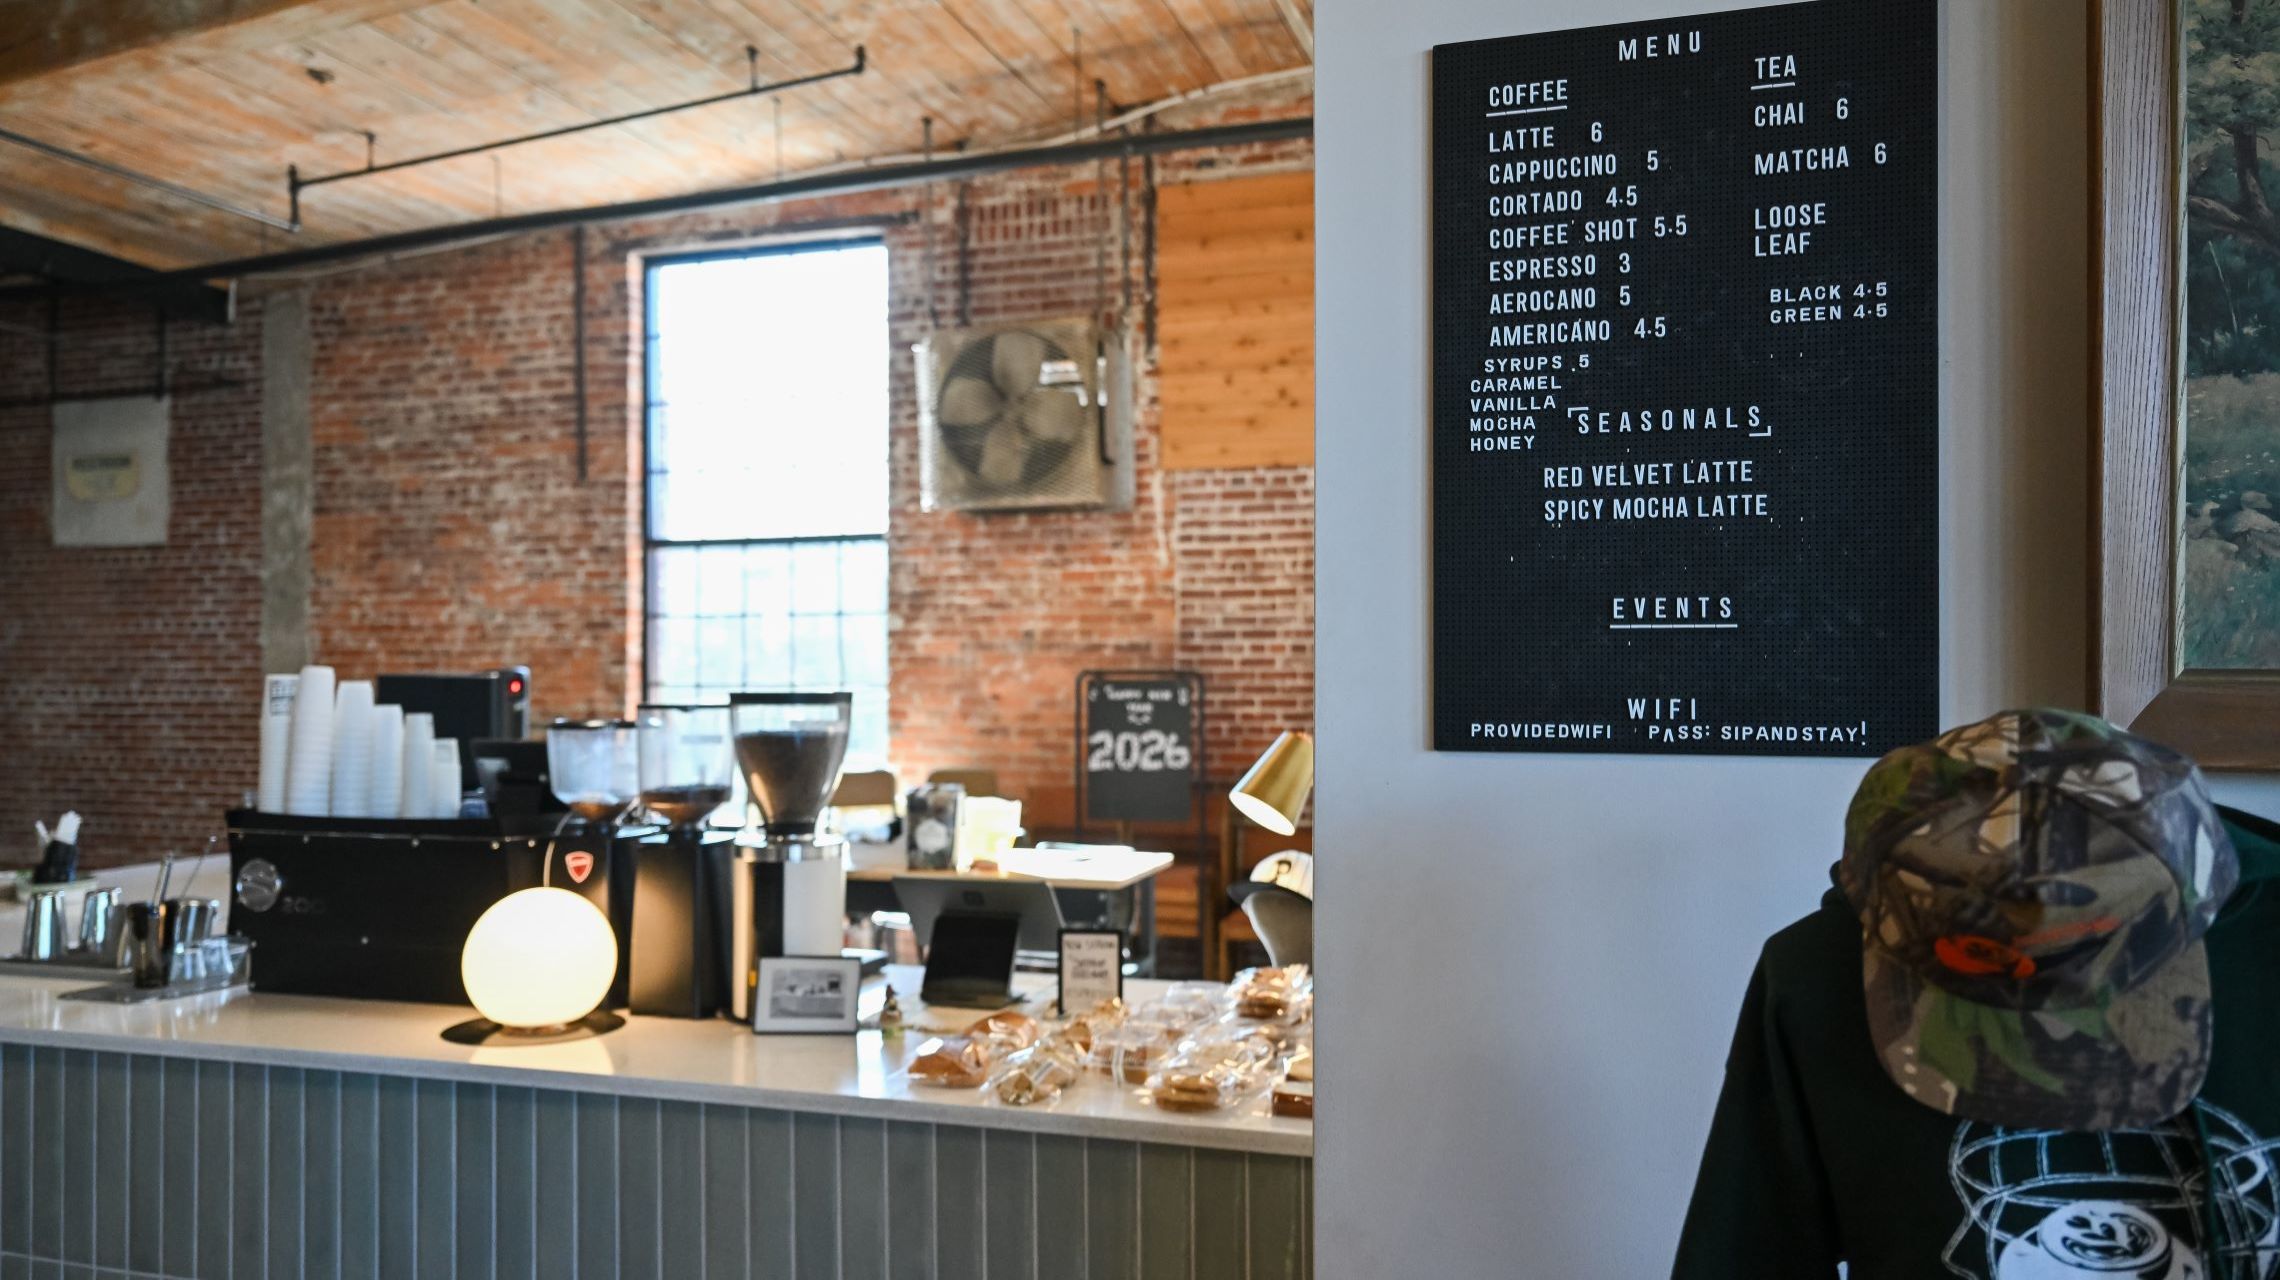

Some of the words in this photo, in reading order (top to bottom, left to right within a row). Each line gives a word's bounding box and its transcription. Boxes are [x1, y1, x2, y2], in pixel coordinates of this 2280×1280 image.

[1619, 31, 1700, 61] MENU
[1755, 55, 1796, 79] TEA
[1490, 80, 1567, 107] COFFEE
[1755, 102, 1803, 126] CHAI
[1837, 98, 1848, 119] 6
[1490, 127, 1554, 152] LATTE
[1592, 122, 1602, 142] 6
[1490, 154, 1616, 184] CAPPUCCINO
[1648, 150, 1658, 170] 5
[1755, 146, 1848, 175] MATCHA
[1875, 143, 1886, 163] 6
[1490, 190, 1581, 216] CORTADO
[1755, 203, 1825, 229] LOOSE
[1490, 225, 1568, 249] COFFEE
[1585, 218, 1637, 242] SHOT
[1755, 232, 1810, 256] LEAF
[1490, 254, 1595, 281] ESPRESSO
[1619, 253, 1630, 273] 3
[1490, 287, 1595, 314] AEROCANO
[1620, 286, 1630, 305] 5
[1771, 285, 1840, 302] BLACK
[1771, 306, 1841, 323] GREEN
[1490, 321, 1609, 346] AMERICANO
[1485, 356, 1561, 372] SYRUPS
[1572, 354, 1589, 371] .5
[1471, 376, 1561, 392] CARAMEL
[1471, 395, 1555, 412] VANILLA
[1470, 415, 1535, 431] MOCHA
[1578, 406, 1760, 433] SEASONALS
[1471, 436, 1534, 451] HONEY
[1544, 467, 1582, 488] RED
[1592, 462, 1673, 486] VELVET
[1684, 461, 1752, 483] LATTE
[1545, 499, 1603, 521] SPICY
[1614, 497, 1688, 519] MOCHA
[1698, 495, 1767, 517] LATTE
[1614, 597, 1730, 619] EVENTS
[1628, 698, 1695, 720] WIFI
[1472, 724, 1610, 738] PROVIDEDWIFI
[1721, 721, 1865, 745] SIPANDSTAY!
[1088, 729, 1191, 770] 2026
